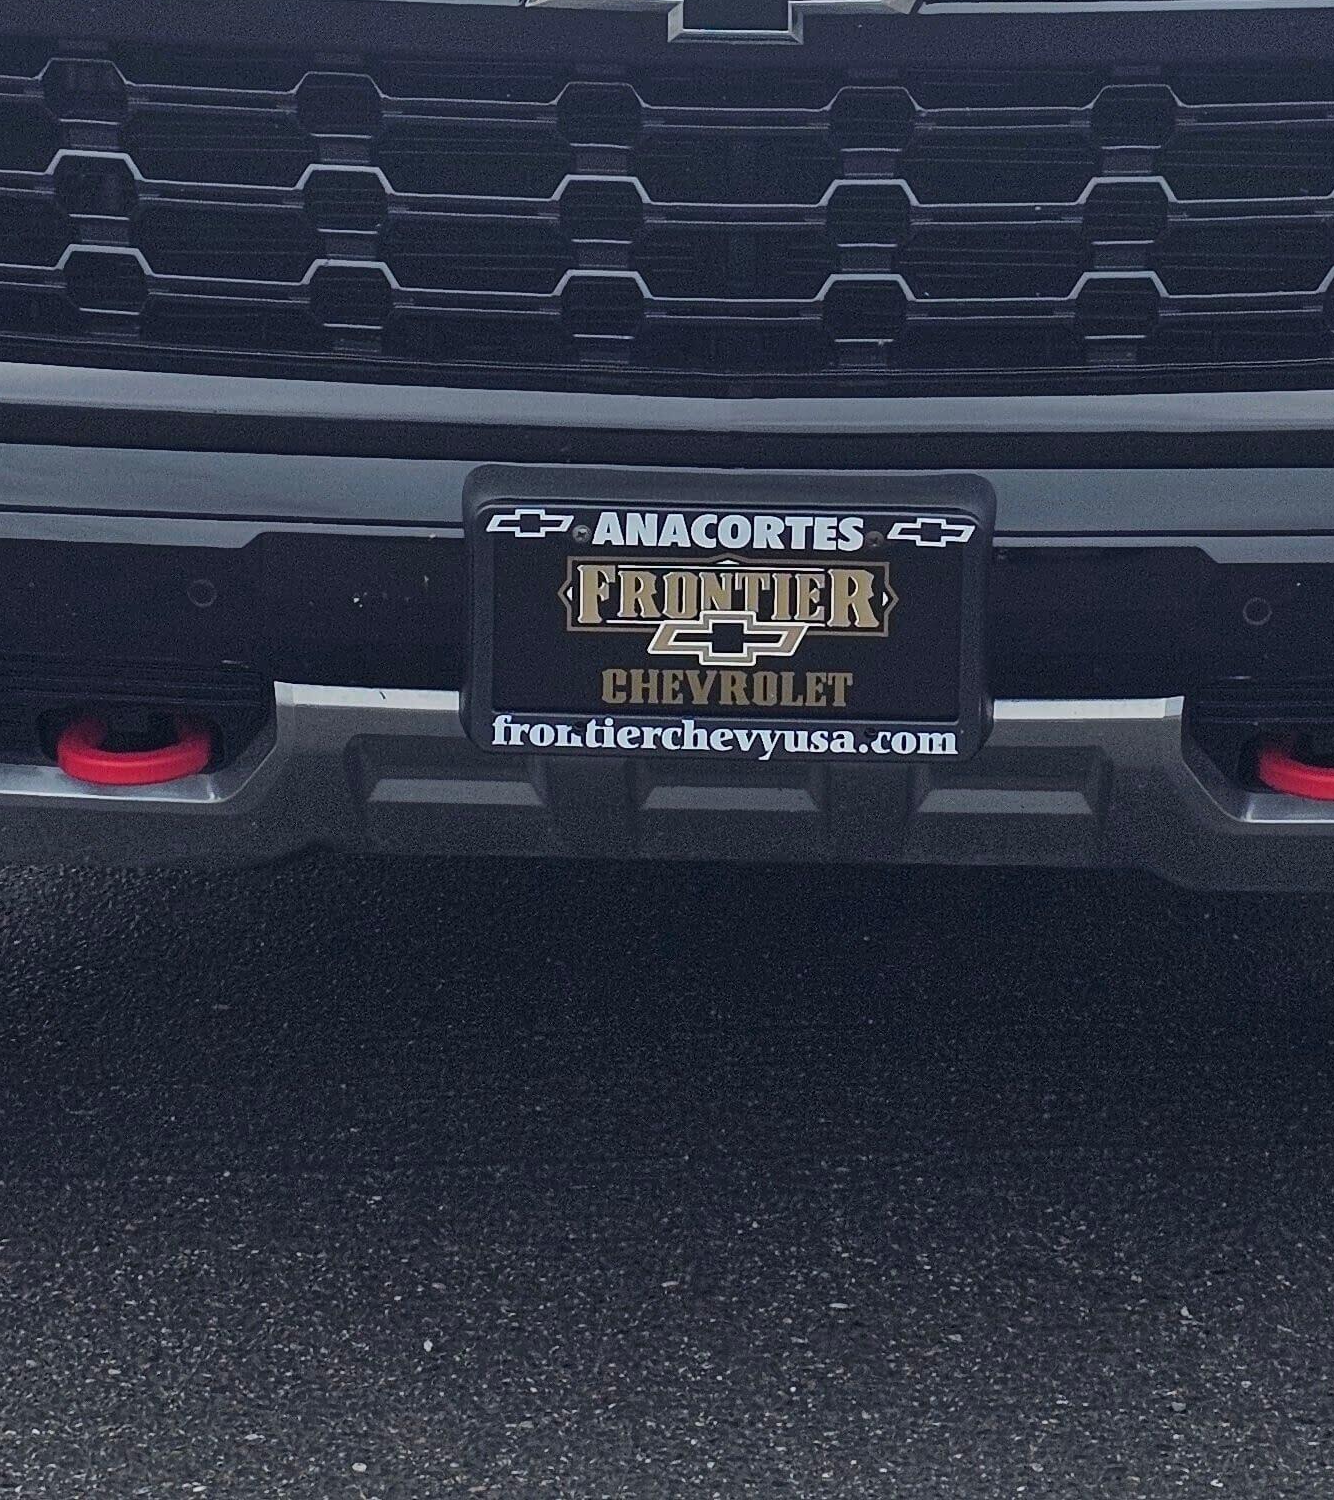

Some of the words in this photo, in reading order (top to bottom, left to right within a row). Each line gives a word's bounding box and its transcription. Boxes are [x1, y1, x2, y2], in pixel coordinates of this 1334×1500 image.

[592, 511, 864, 551] ANACORTES
[576, 563, 880, 628] FRONTIER
[601, 668, 854, 707] CHEVROLET
[491, 713, 958, 760] frontierchevyusa.com
